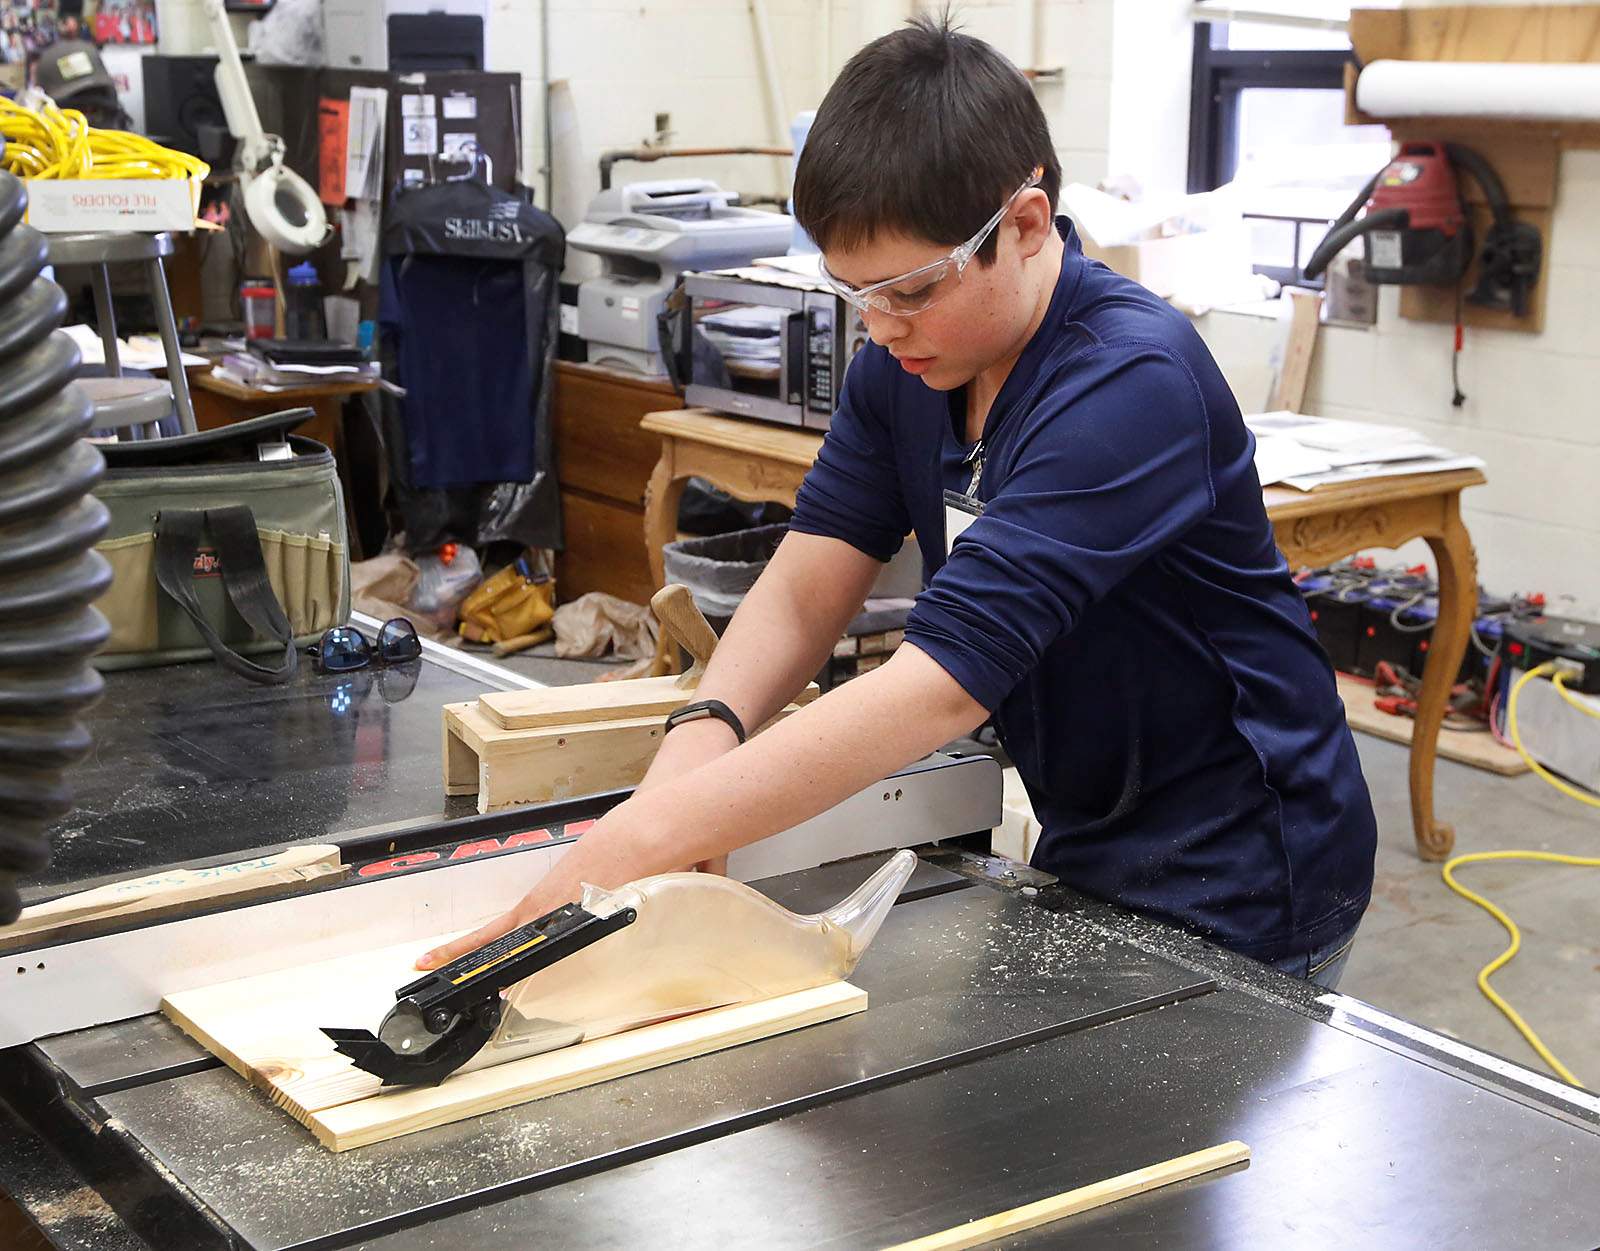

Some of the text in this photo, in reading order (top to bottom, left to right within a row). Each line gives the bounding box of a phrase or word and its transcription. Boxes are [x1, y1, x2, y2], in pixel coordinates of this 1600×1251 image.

[72, 193, 129, 207] FOLDERS
[133, 193, 157, 207] FILE
[194, 859, 277, 878] Table
